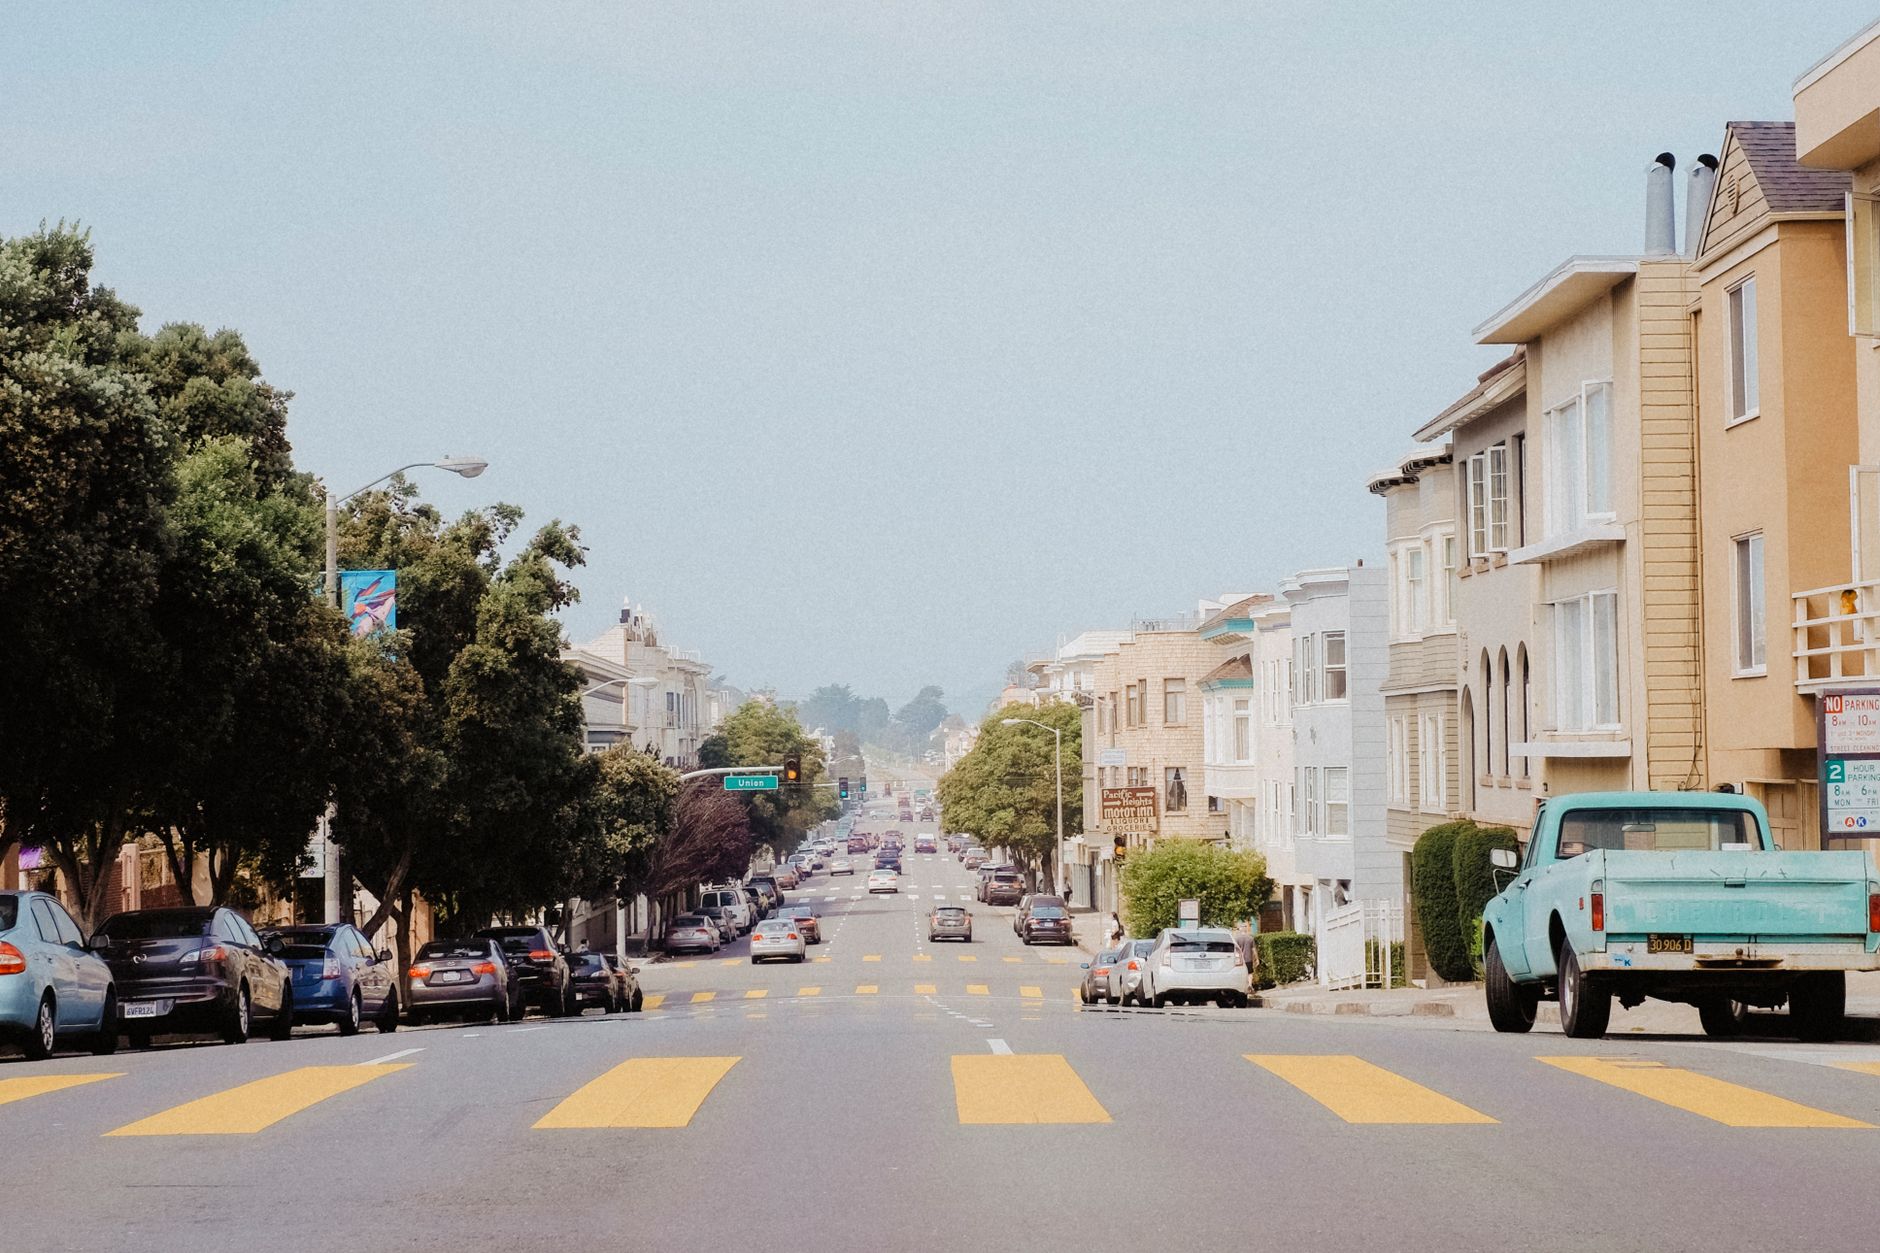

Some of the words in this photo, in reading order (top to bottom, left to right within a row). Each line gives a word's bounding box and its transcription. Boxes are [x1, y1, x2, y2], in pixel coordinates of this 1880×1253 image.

[1826, 696, 1841, 712] NO
[1845, 699, 1880, 711] PARKING
[1829, 764, 1842, 780] 2
[1853, 764, 1875, 773] HOUR
[1847, 774, 1880, 782] PARKING
[738, 779, 764, 787] Union
[1103, 789, 1133, 799] Pacific
[1122, 797, 1153, 806] Heights
[1834, 799, 1851, 807] MON
[1867, 798, 1879, 806] FRI
[1104, 807, 1136, 819] motor
[1624, 959, 1631, 967] K
